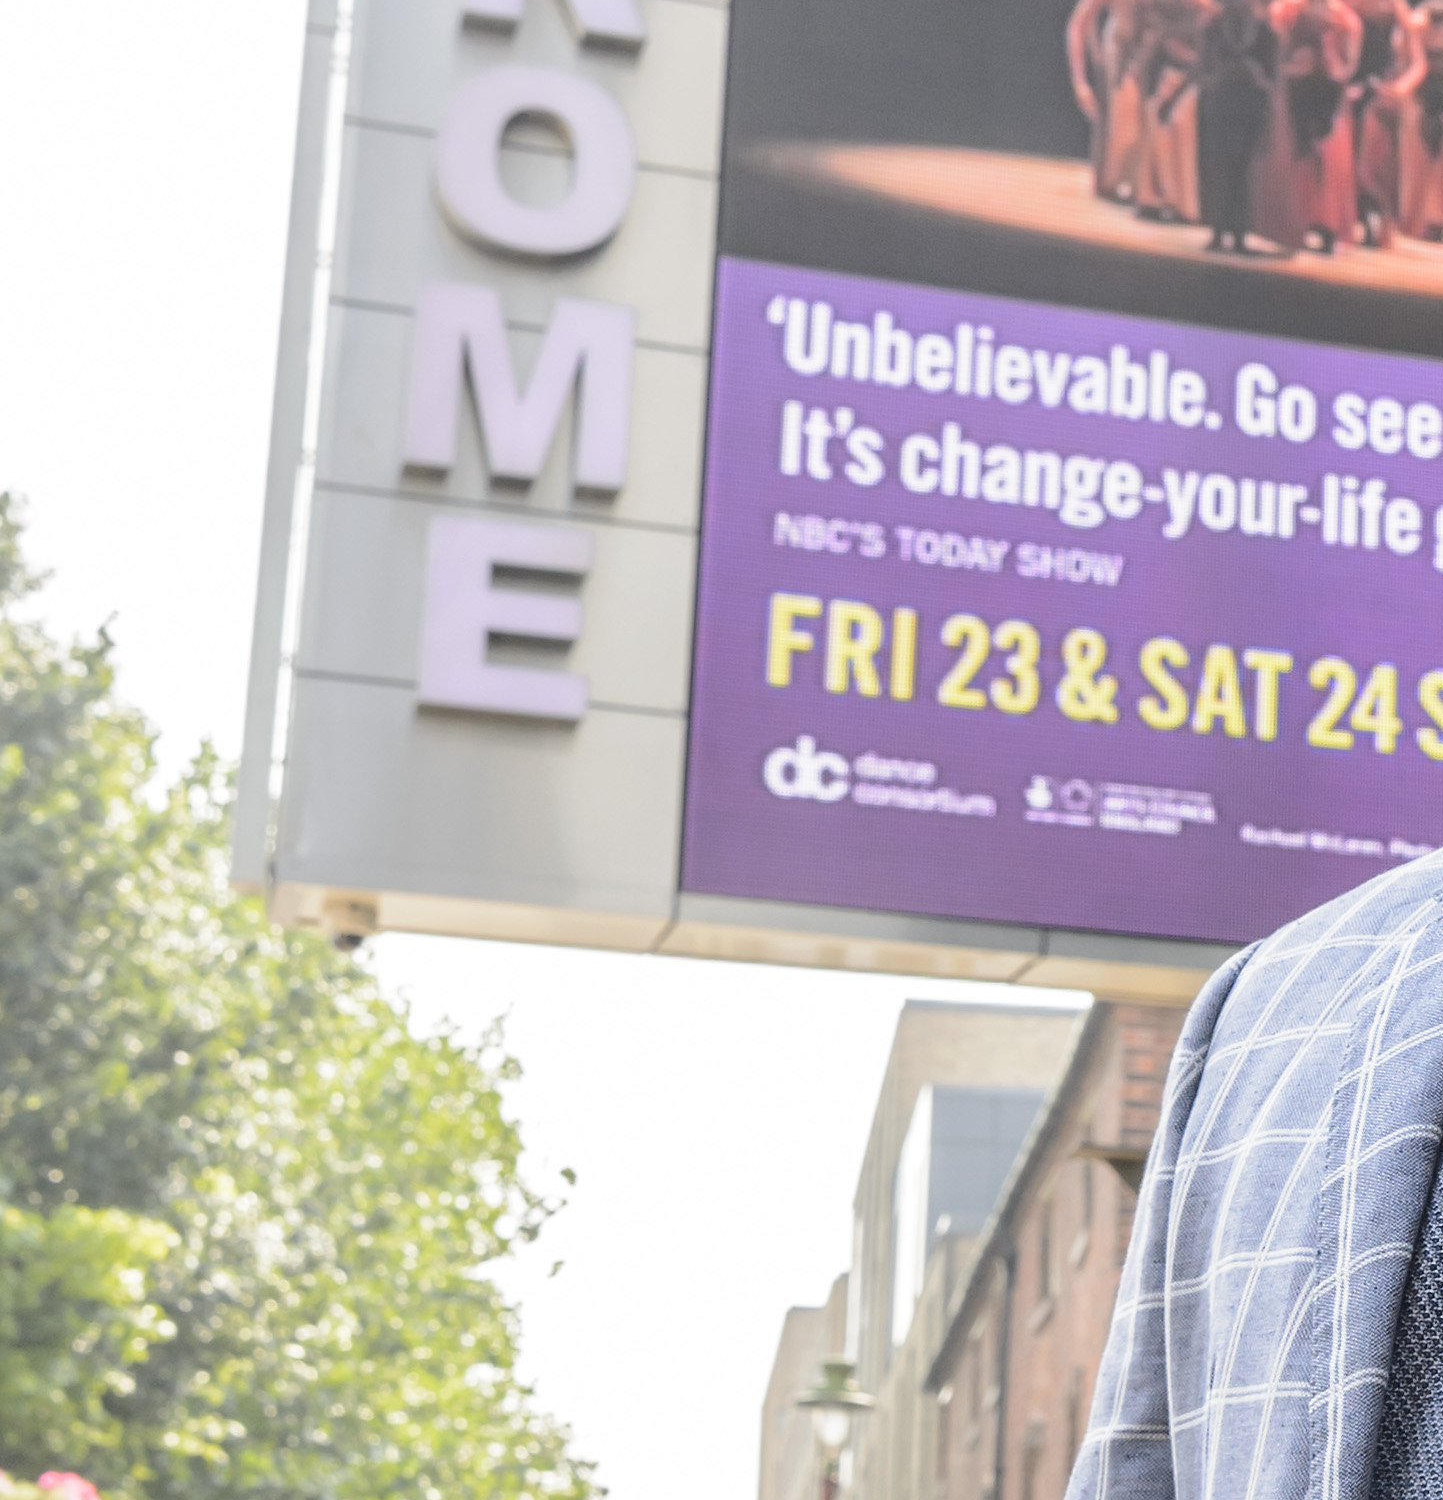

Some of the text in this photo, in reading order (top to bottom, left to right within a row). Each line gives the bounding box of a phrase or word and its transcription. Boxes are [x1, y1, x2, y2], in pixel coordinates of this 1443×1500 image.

[1235, 362, 1317, 445] Go
[1332, 391, 1443, 461] see
[900, 420, 1422, 553] change-your-life
[895, 525, 1011, 573] TODAY
[1015, 541, 1124, 586] SHOW
[766, 591, 919, 701] FRI
[937, 612, 1042, 716] 23
[1056, 626, 1121, 725] &
[1138, 635, 1293, 742] SAT
[1306, 655, 1401, 755] 24
